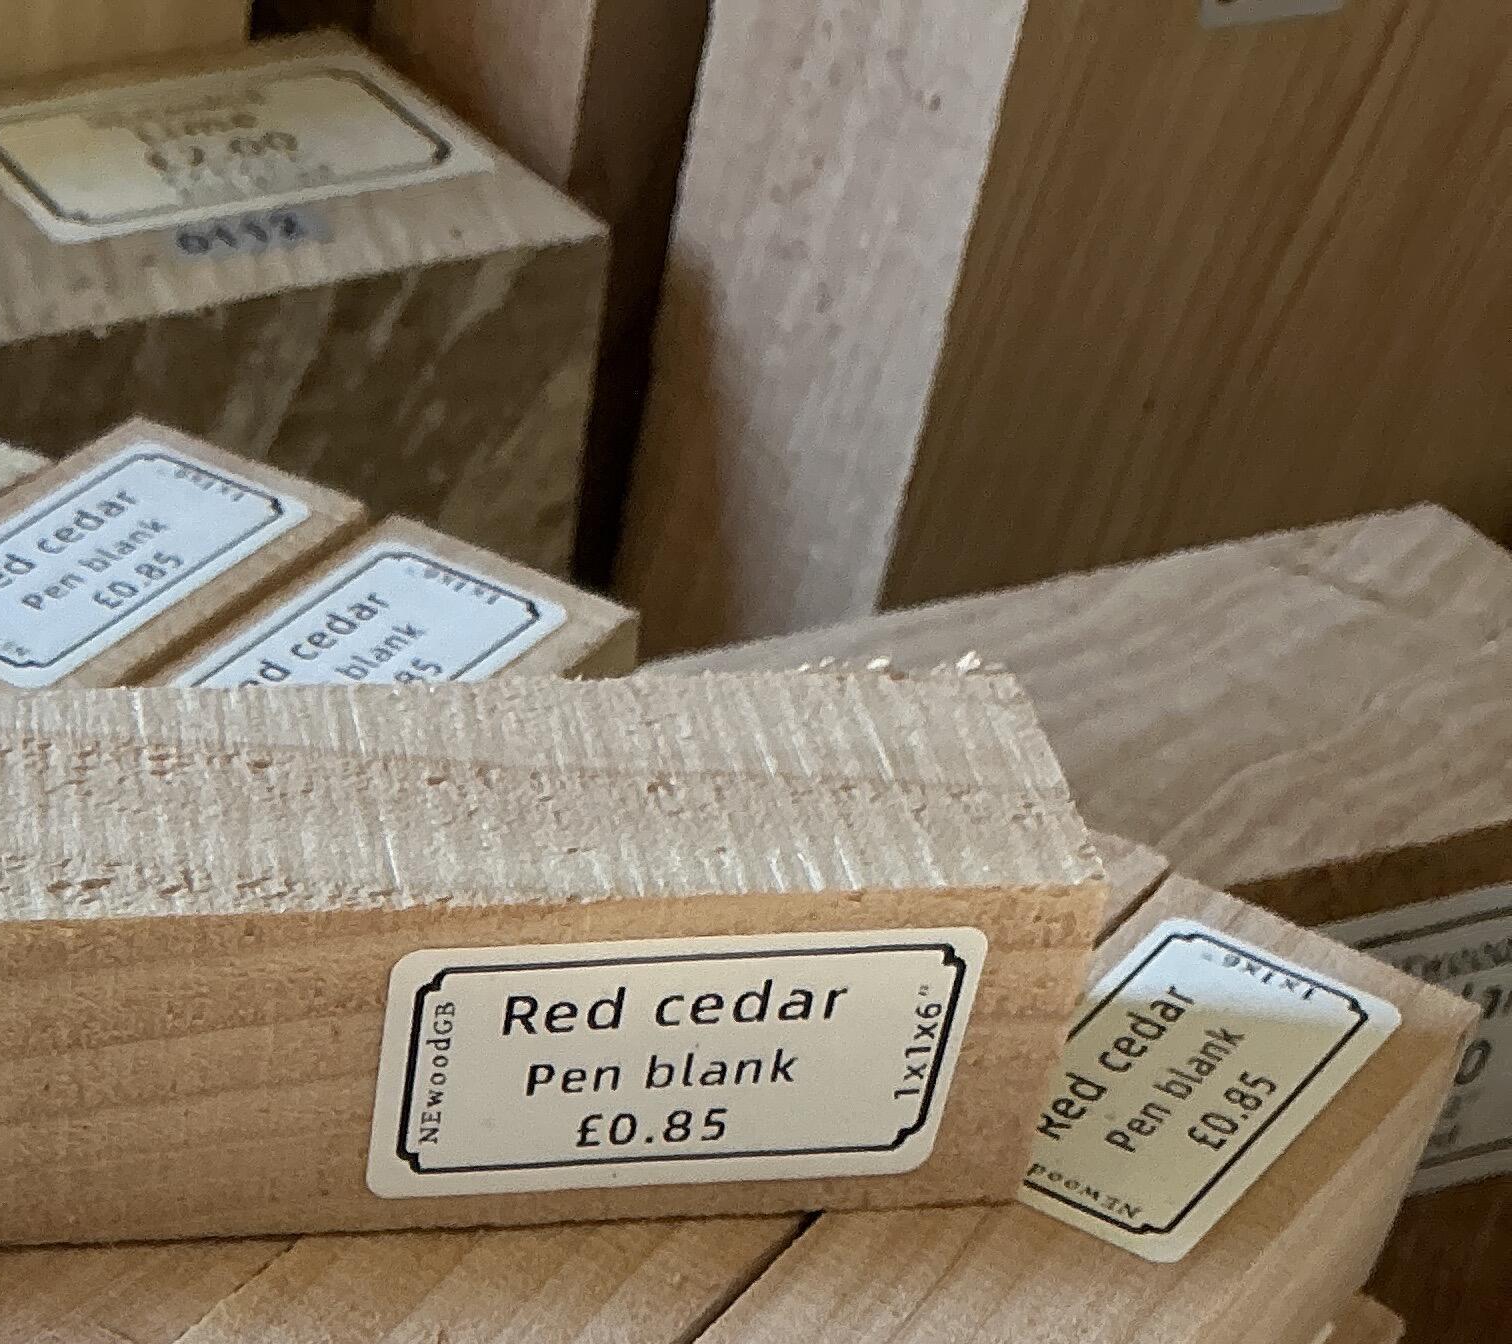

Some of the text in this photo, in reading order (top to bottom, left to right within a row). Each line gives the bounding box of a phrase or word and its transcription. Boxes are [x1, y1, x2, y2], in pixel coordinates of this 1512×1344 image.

[37, 489, 137, 555] cedar
[21, 518, 169, 611] Pen blank
[93, 550, 184, 610] £0.85
[290, 592, 389, 661] cedar
[334, 622, 426, 681] blank
[500, 978, 850, 1036] Red cedar
[1098, 984, 1195, 1074] cedar
[417, 1000, 456, 1145] NEwoodGB
[524, 1047, 797, 1096] Pen blank
[1103, 1024, 1246, 1154] Pen blank
[575, 1107, 729, 1148] £0.85
[1187, 1069, 1278, 1152] £0.85
